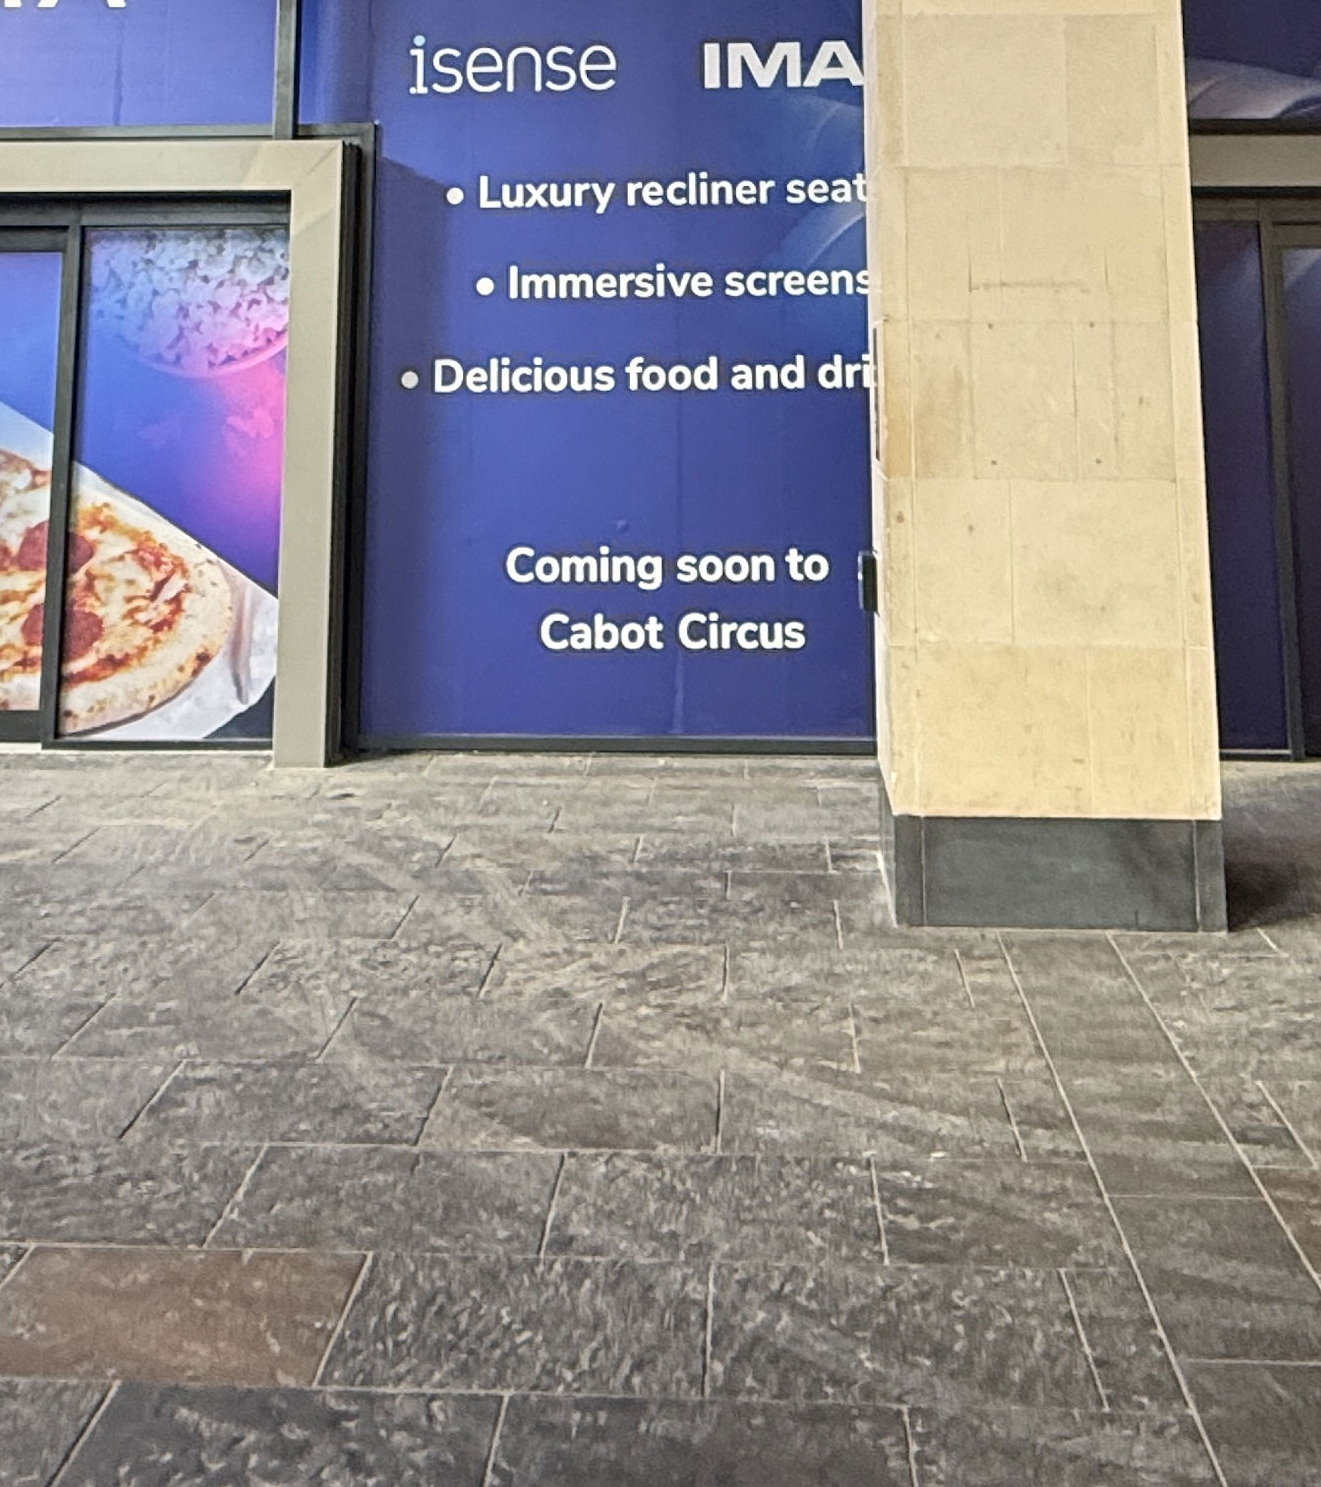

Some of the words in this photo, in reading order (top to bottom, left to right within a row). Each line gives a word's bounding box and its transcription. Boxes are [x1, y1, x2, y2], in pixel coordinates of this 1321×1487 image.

[409, 34, 618, 94] isense
[703, 39, 865, 89] IMA
[478, 174, 615, 214] Luxury
[626, 170, 776, 207] recliner
[508, 264, 714, 300] Immersive
[724, 267, 870, 298] screens
[434, 356, 615, 395] Delicious
[625, 355, 719, 392] food
[730, 354, 805, 391] and
[817, 353, 872, 391] dri
[505, 546, 663, 591] Coming
[676, 551, 776, 584] soon
[785, 549, 830, 583] to
[539, 612, 664, 651] Cabot
[678, 611, 806, 651] Circus
